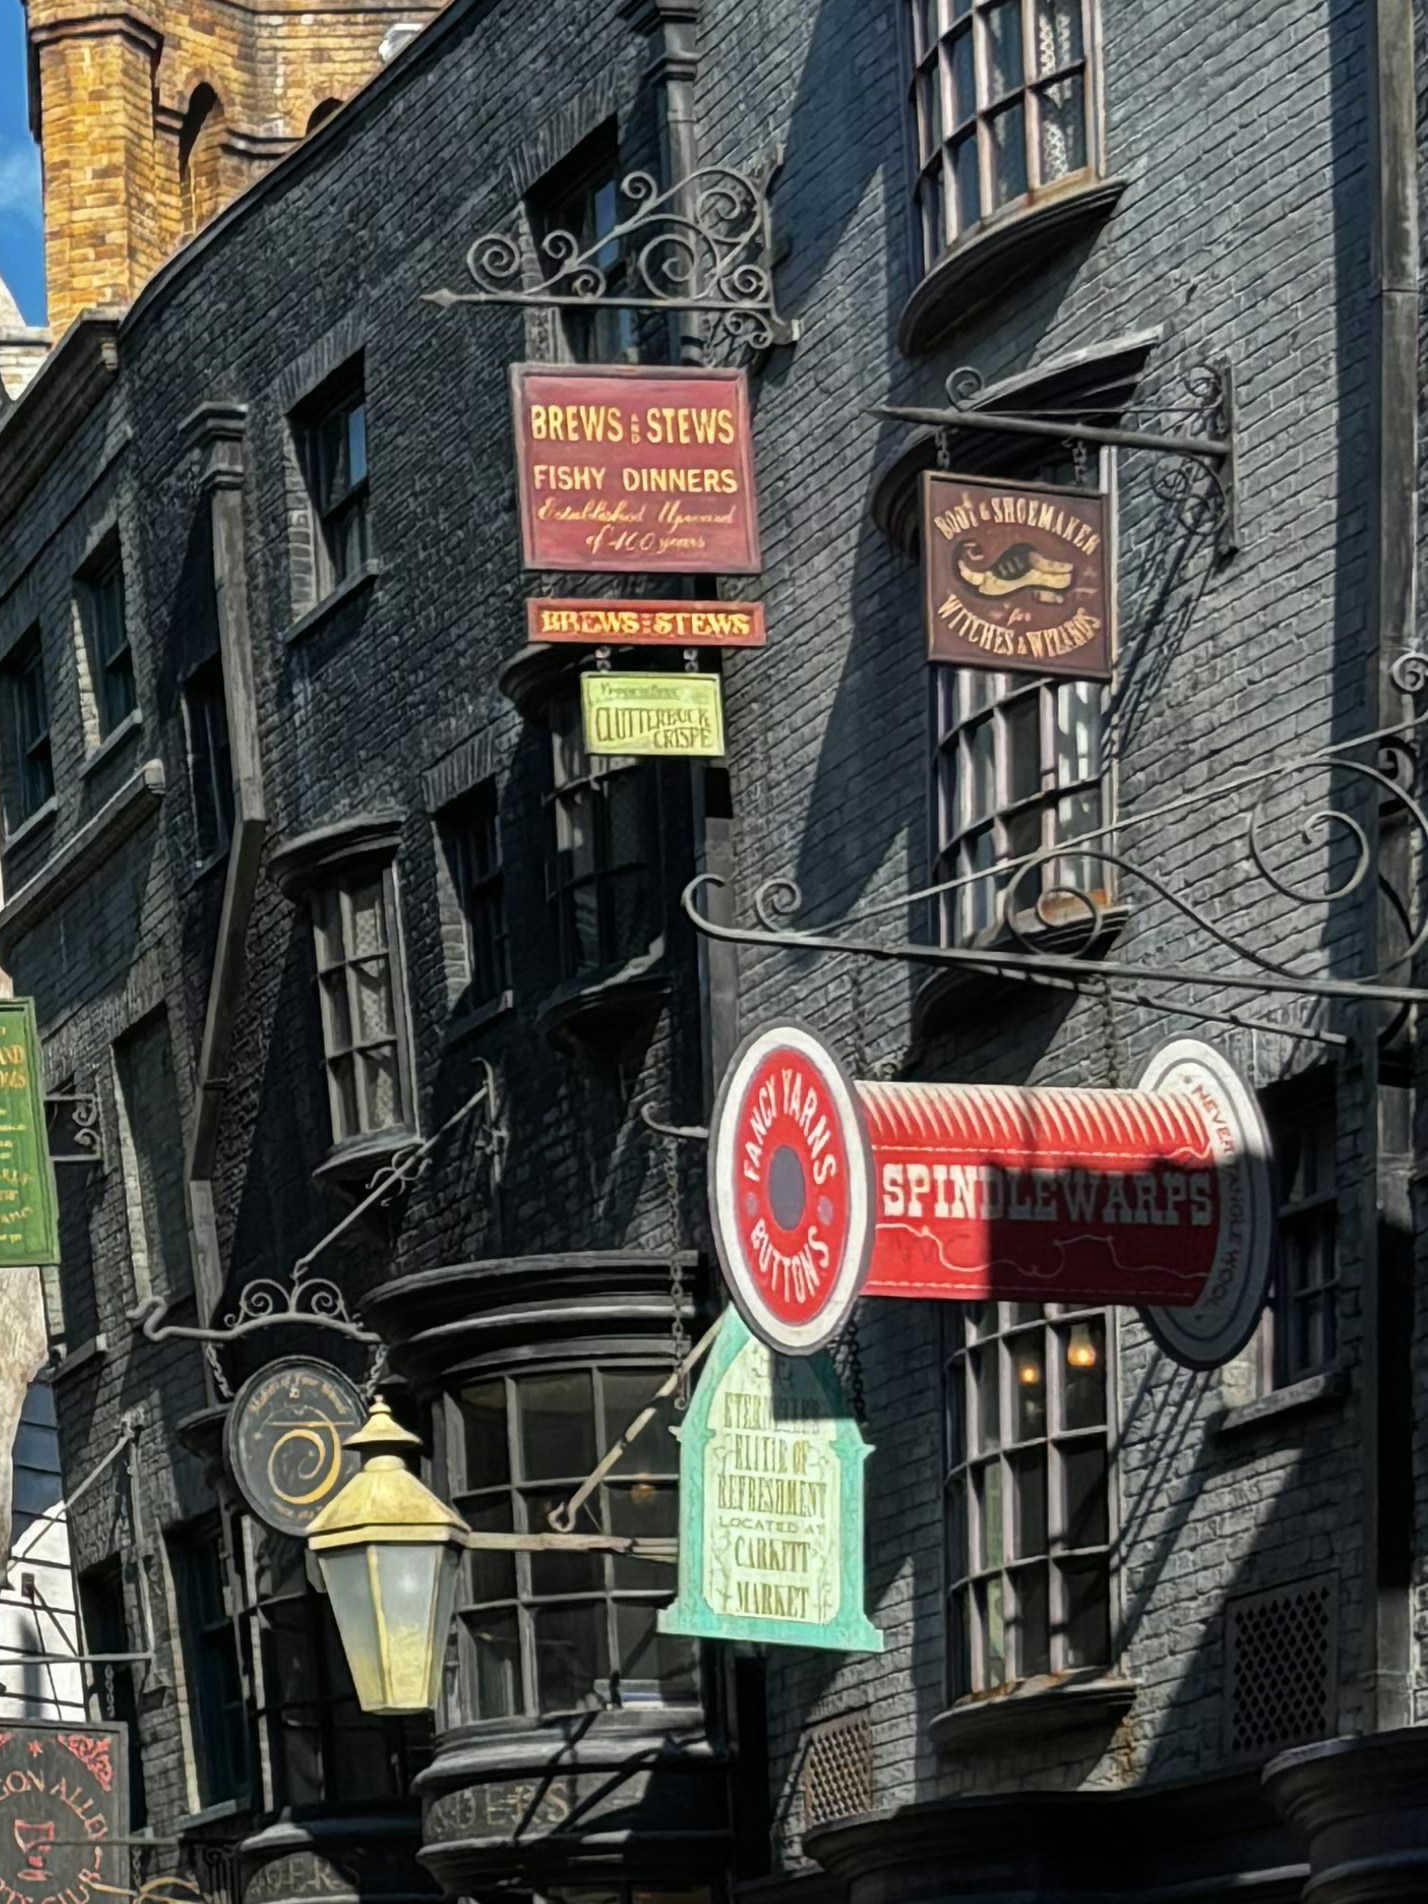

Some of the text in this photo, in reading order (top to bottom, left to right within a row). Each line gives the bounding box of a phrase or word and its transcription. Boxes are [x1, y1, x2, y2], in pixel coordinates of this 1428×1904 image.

[531, 405, 735, 445] BREWS AND STEWS
[533, 465, 738, 494] FISHY DINNERS
[585, 524, 613, 555] of
[990, 497, 1101, 556] SHOEMAKER
[541, 610, 640, 634] BREWS
[653, 612, 751, 636] STEWS
[937, 594, 1015, 656] WITCHES
[1025, 607, 1101, 659] WIZARDS
[652, 726, 712, 749] CRISPE
[744, 1068, 837, 1186] FANCY YARNS
[1191, 1083, 1235, 1154] NEVER
[882, 1162, 1213, 1226] SPINDLEWARPS
[750, 1217, 830, 1304] BUTTONS
[717, 1474, 827, 1518] REFRESHMENT
[719, 1516, 826, 1536] LOCATED AT
[735, 1535, 811, 1573] CARKITT
[736, 1581, 809, 1619] MARKET
